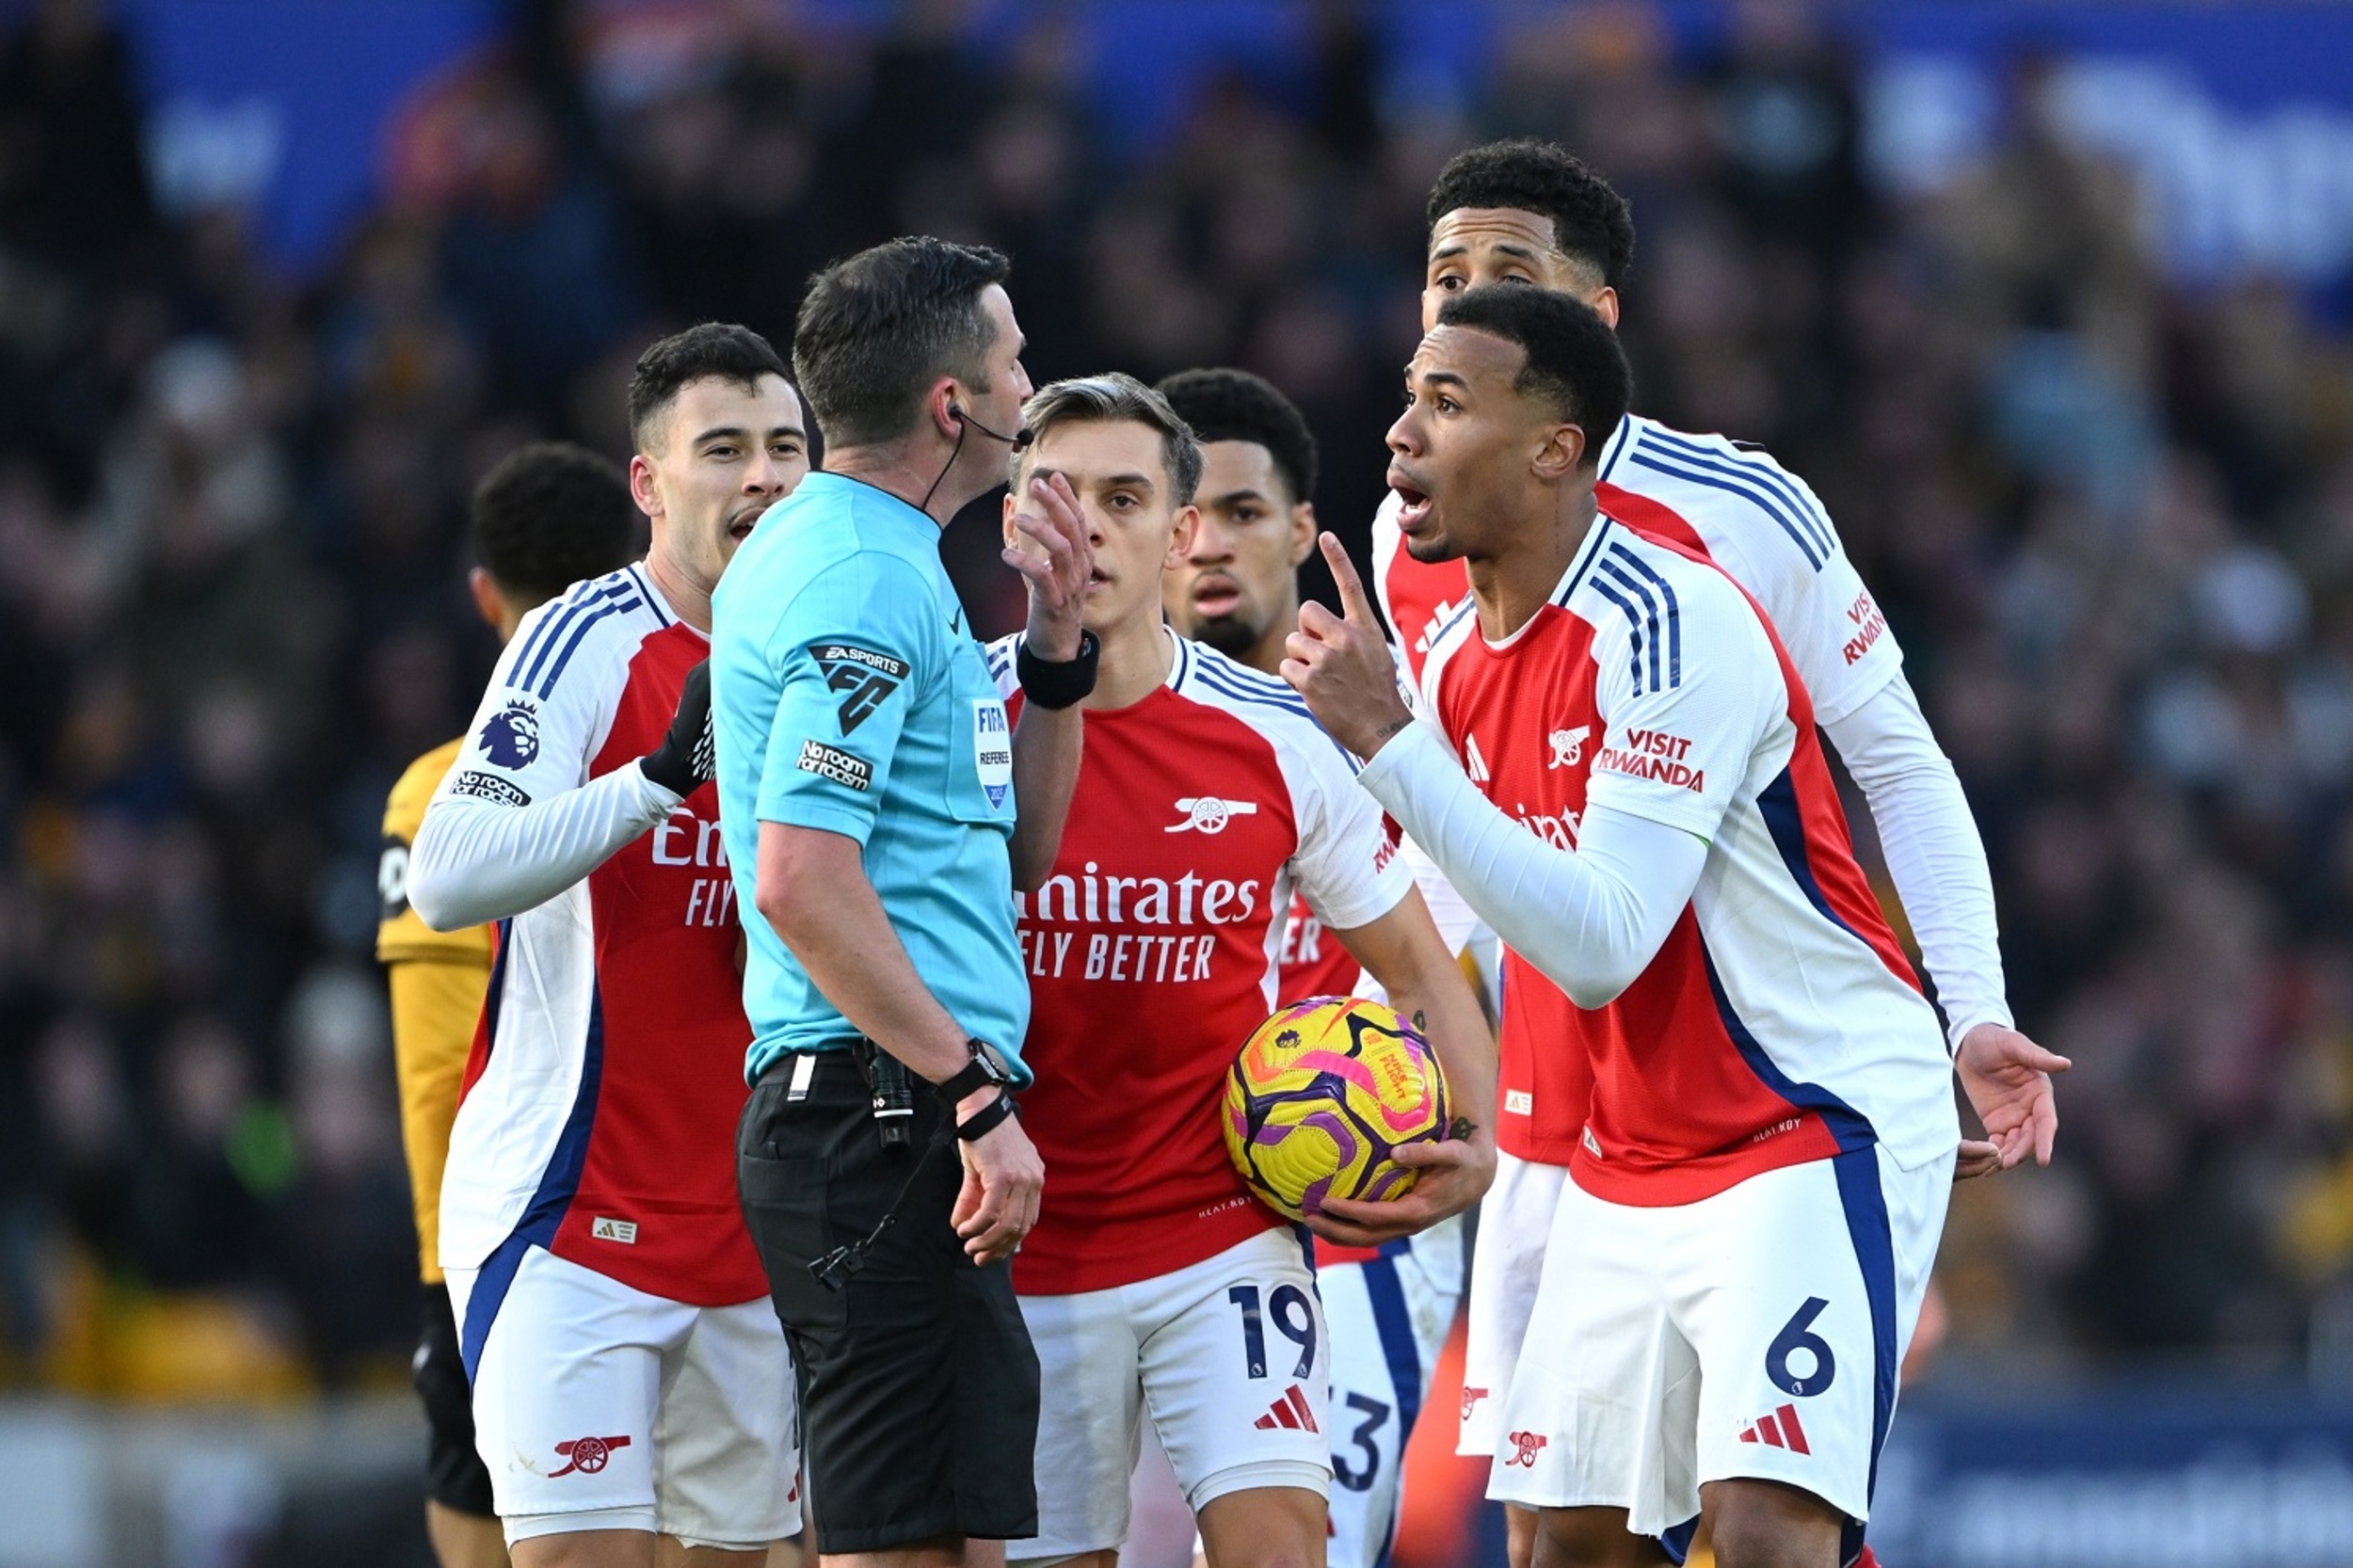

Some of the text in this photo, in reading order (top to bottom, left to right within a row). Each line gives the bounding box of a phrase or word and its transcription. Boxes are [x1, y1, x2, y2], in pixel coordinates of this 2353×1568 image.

[825, 646, 900, 675] EA SPORTS
[979, 707, 1006, 733] FIFA
[802, 740, 867, 776] No room
[980, 751, 1010, 765] REFEREE
[1626, 728, 1692, 761] VISIT
[454, 772, 523, 805] No room
[796, 754, 870, 791] for racism
[1597, 747, 1705, 793] RWANDA
[1014, 861, 1259, 925] mirates
[1084, 934, 1216, 983] BETTER
[1379, 1056, 1406, 1100] FLIGHT
[1387, 1053, 1408, 1083] NIKE
[1228, 1284, 1318, 1380] 19
[1765, 1295, 1836, 1398] 6
[1328, 1385, 1392, 1494] 3
